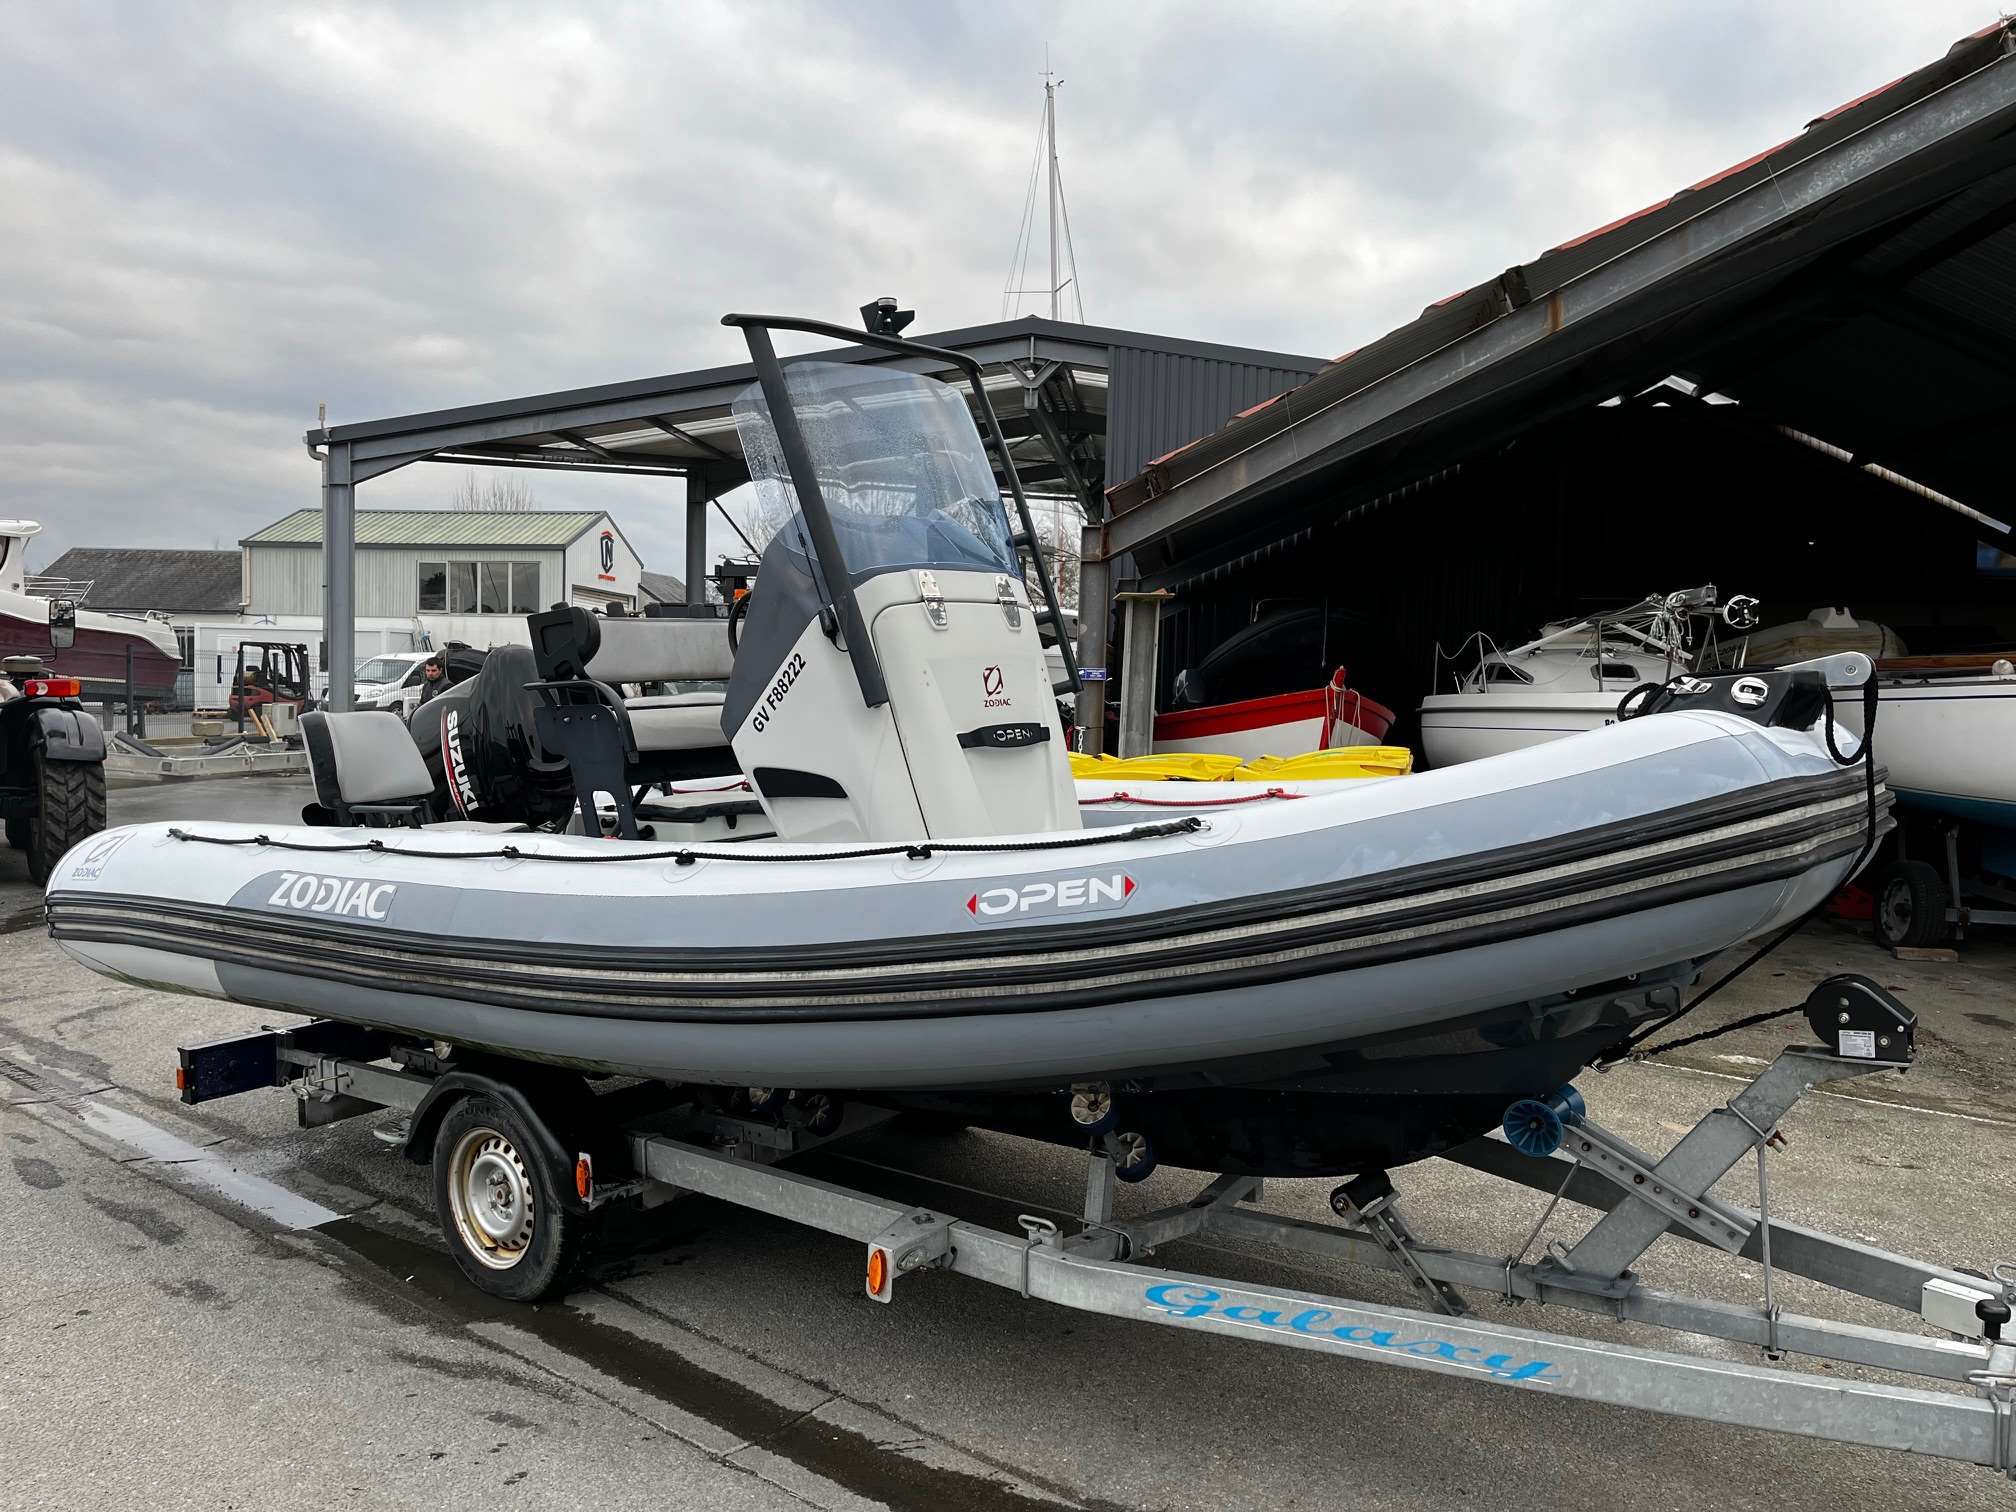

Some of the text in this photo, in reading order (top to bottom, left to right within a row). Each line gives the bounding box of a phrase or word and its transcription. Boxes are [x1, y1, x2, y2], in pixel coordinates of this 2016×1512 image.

[753, 653, 807, 733] GV F88222
[984, 698, 1012, 708] ZODIAC
[996, 728, 1031, 742] OPEN
[446, 710, 480, 812] SUZUKI
[268, 873, 397, 919] ZODIAC
[978, 874, 1122, 916] OPEN
[1145, 1284, 1562, 1381] Galaxy
